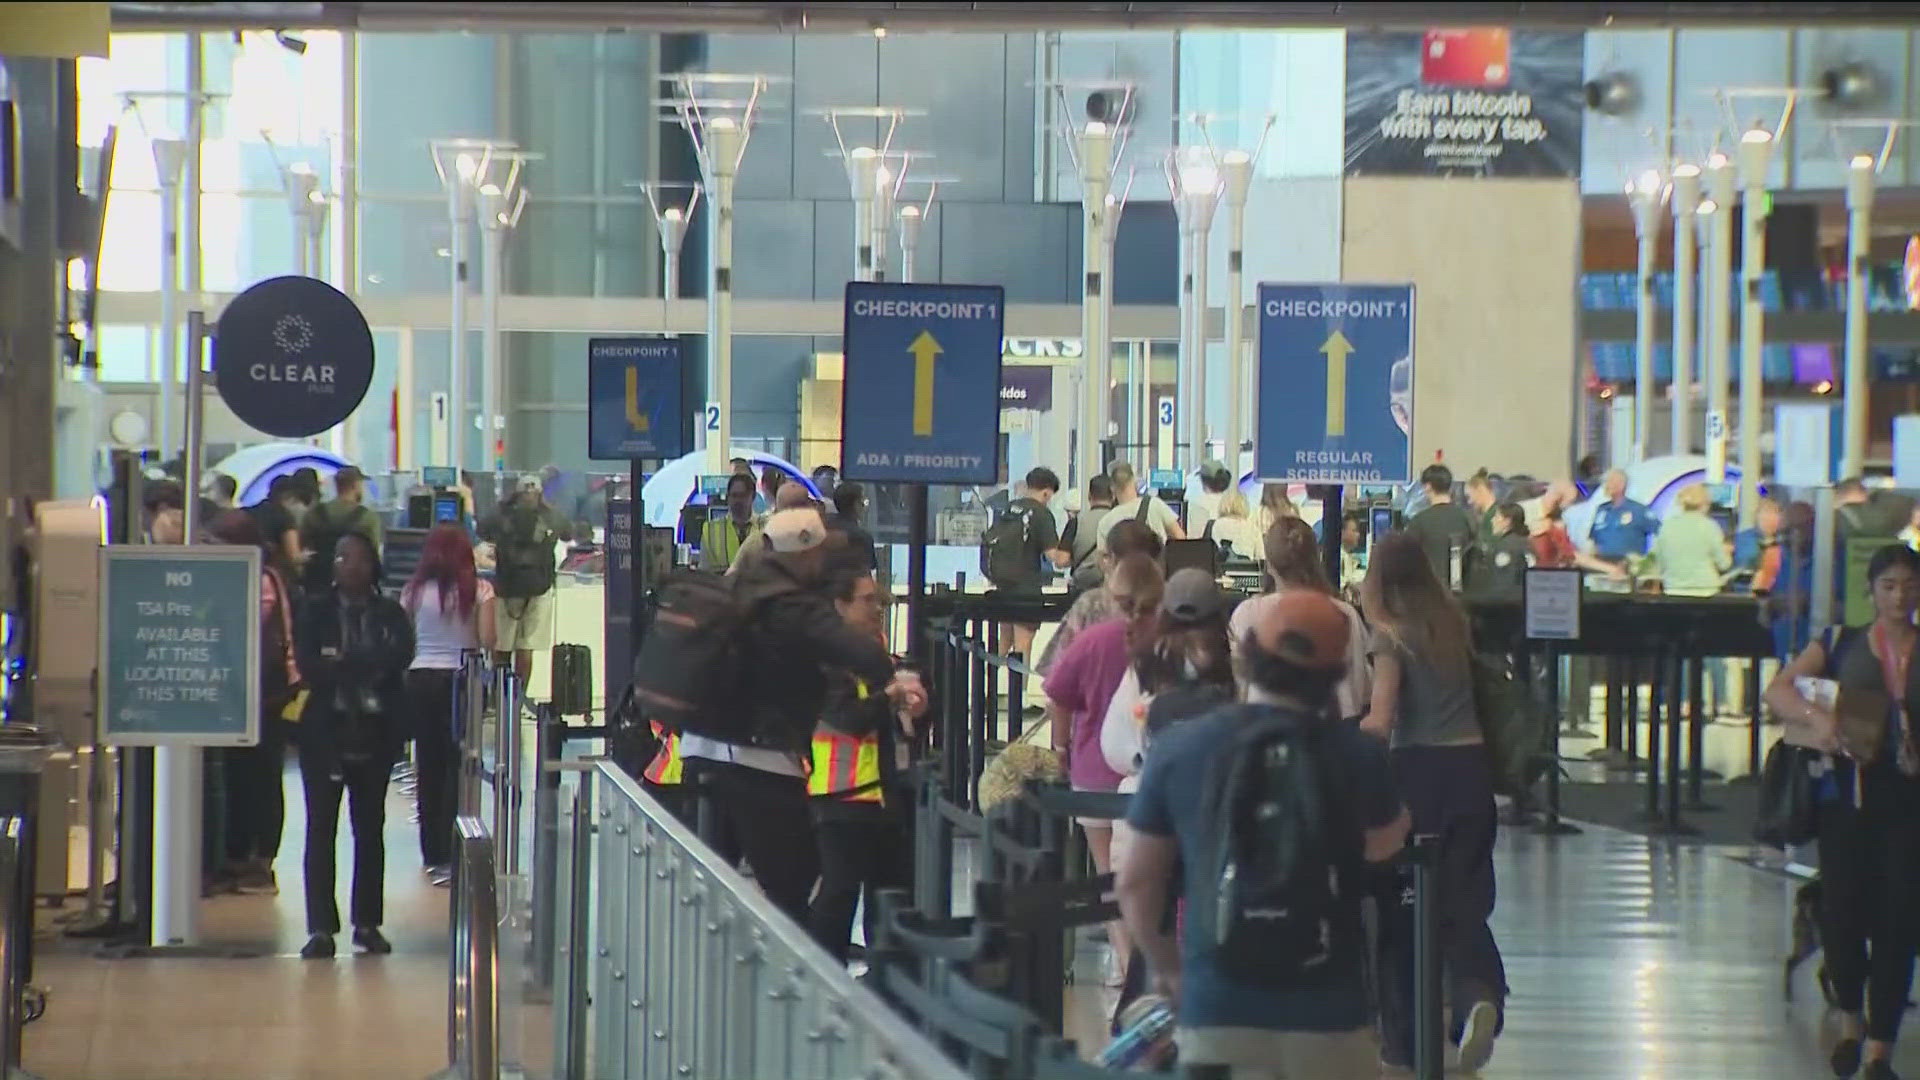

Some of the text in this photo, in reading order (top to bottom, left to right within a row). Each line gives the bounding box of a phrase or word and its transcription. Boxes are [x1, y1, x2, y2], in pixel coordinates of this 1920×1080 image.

[1397, 89, 1532, 116] Earn bitcoin
[1380, 114, 1547, 144] with every tap.
[854, 300, 996, 319] CHECKPOINT 1
[1265, 301, 1407, 318] CHECKPOINT 1
[593, 346, 678, 358] CHECKPOINT 1
[250, 363, 336, 383] CLEAR
[435, 396, 444, 420] 1
[1160, 402, 1173, 426] 3
[707, 406, 720, 430] 2
[856, 454, 890, 466] ADA
[904, 455, 982, 468] PRIORITY
[1295, 452, 1373, 465] REGULAR
[1287, 469, 1381, 481] SCREENING
[165, 572, 192, 586] NO
[136, 602, 192, 616] TSA Pre
[136, 628, 220, 642] AVAILABLE
[146, 648, 209, 662] AT THIS
[125, 668, 231, 682] LOCATION AT
[137, 687, 218, 701] THIS TIME
